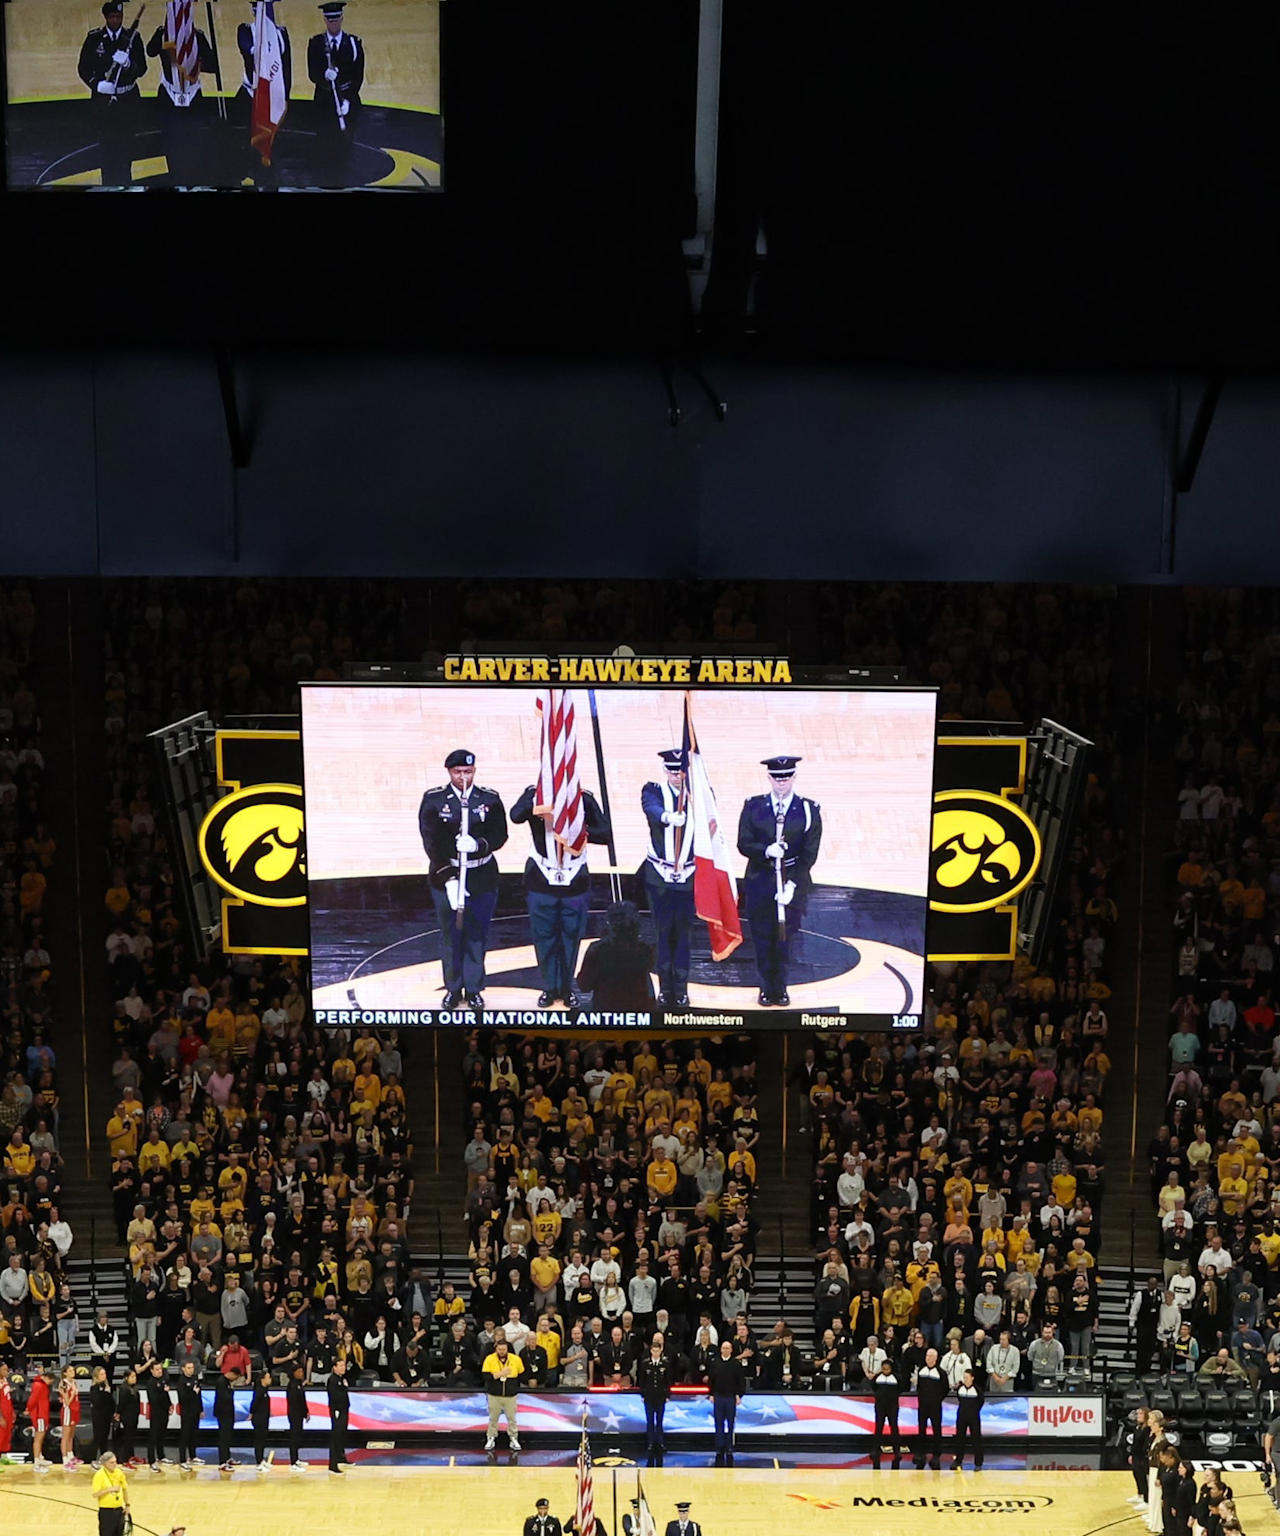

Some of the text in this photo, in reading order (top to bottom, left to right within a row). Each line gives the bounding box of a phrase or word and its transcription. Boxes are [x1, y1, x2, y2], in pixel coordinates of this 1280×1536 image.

[443, 657, 792, 683] CARVER-HAWKEYE ARENA
[315, 1010, 651, 1026] PERFORMING OUR NATIONAL ANTHEM
[664, 1013, 744, 1026] Northwestern
[801, 1014, 847, 1028] Rutgers
[892, 1015, 919, 1028] 1:00
[539, 1223, 554, 1232] 22
[852, 1496, 1037, 1508] Mediacom
